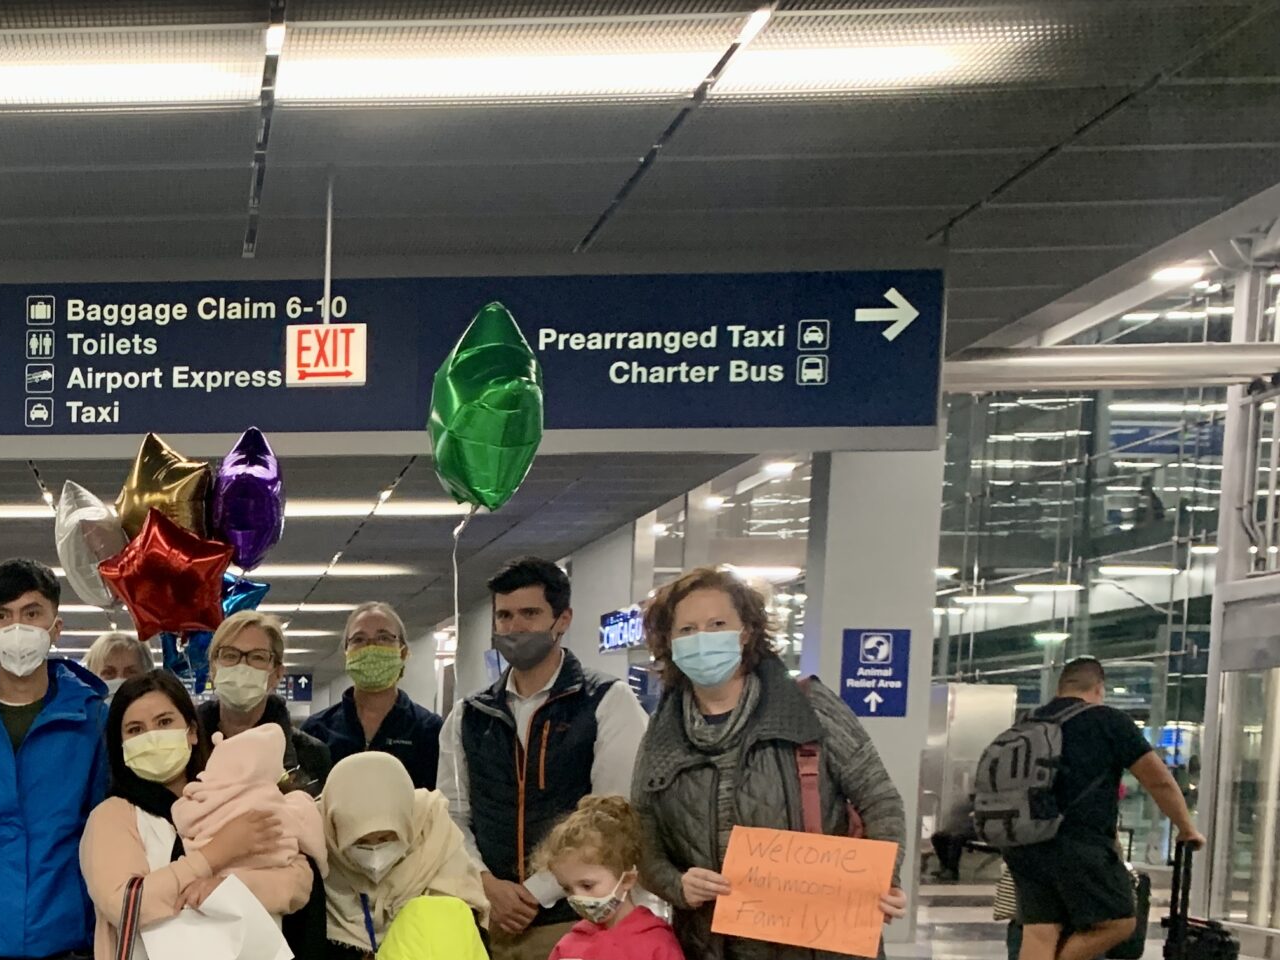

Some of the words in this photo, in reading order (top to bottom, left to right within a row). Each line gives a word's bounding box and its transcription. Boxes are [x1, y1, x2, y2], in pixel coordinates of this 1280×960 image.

[67, 299, 188, 326] Baggage
[197, 297, 276, 320] Claim
[286, 296, 347, 318] 6-10
[67, 332, 158, 355] Toilets
[297, 328, 355, 368] EXIT
[538, 325, 717, 354] Prearranged
[727, 324, 785, 348] Taxi
[67, 367, 163, 394] Airport
[172, 365, 282, 391] Express
[609, 361, 720, 384] Charter
[729, 360, 784, 382] Bus
[66, 400, 120, 423] Taxi
[846, 678, 876, 688] Relief
[877, 678, 902, 688] Area
[856, 667, 893, 677] Animal
[746, 833, 867, 874] Welcome
